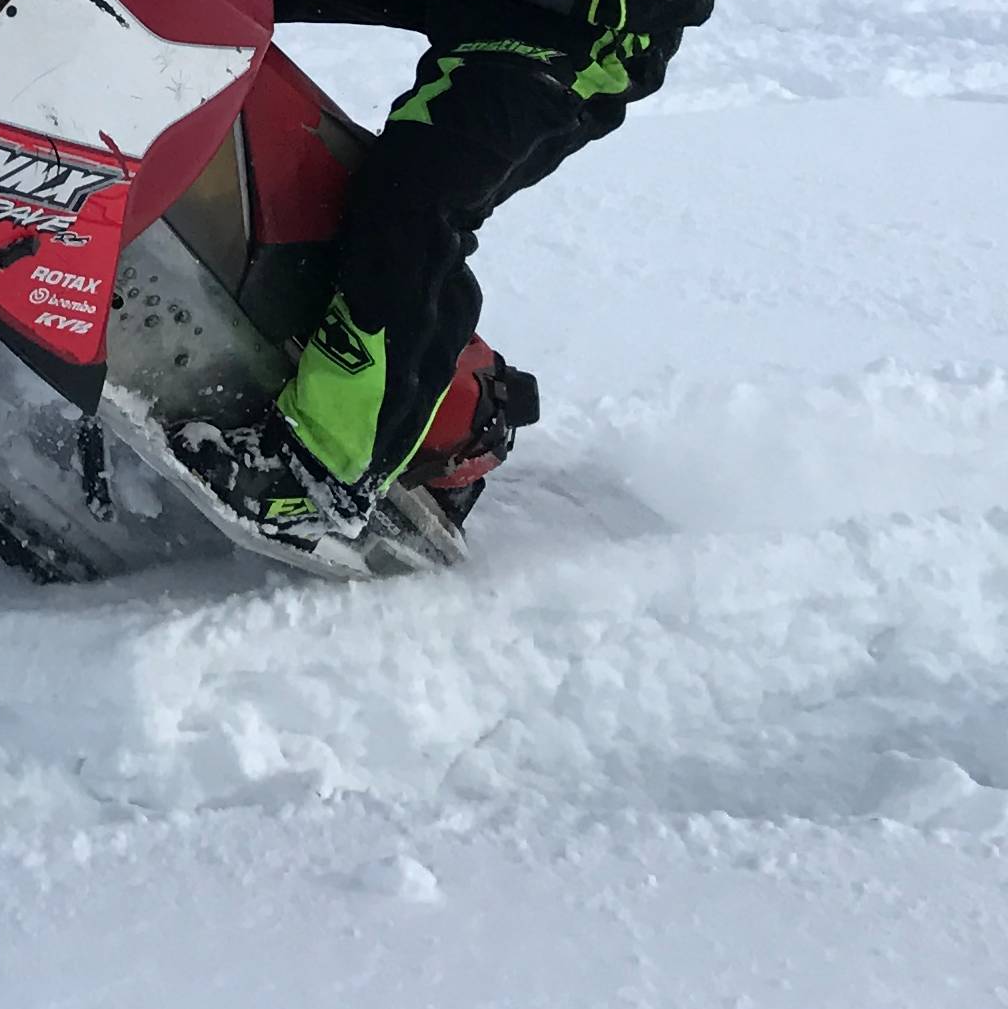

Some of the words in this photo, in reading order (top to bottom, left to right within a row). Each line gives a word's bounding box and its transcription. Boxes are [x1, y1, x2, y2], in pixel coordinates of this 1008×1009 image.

[30, 265, 103, 294] ROTAX
[48, 293, 97, 314] brembo
[33, 311, 94, 334] KYB
